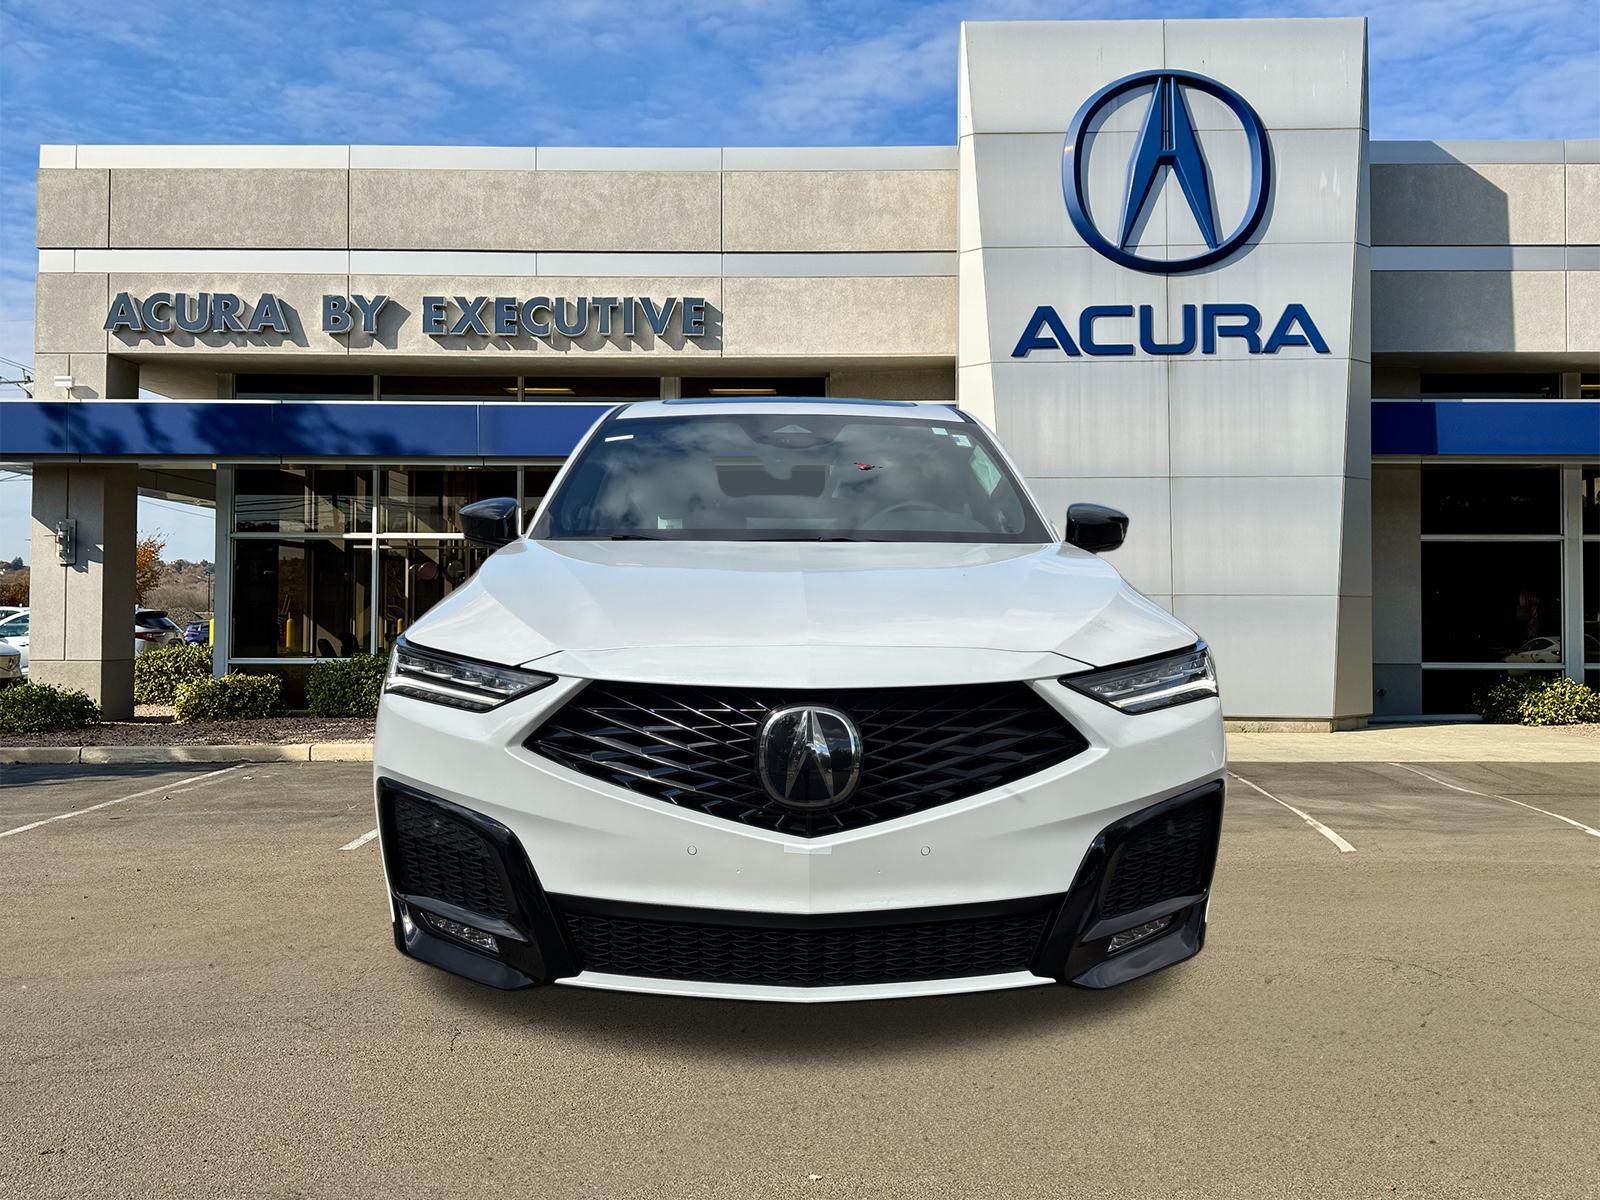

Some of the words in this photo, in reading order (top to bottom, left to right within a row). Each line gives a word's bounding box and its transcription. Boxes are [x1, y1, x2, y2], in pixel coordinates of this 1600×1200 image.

[104, 291, 290, 334] ACURA
[322, 294, 390, 335] BY
[423, 295, 708, 337] EXECUTIVE
[1011, 303, 1332, 357] ACURA
